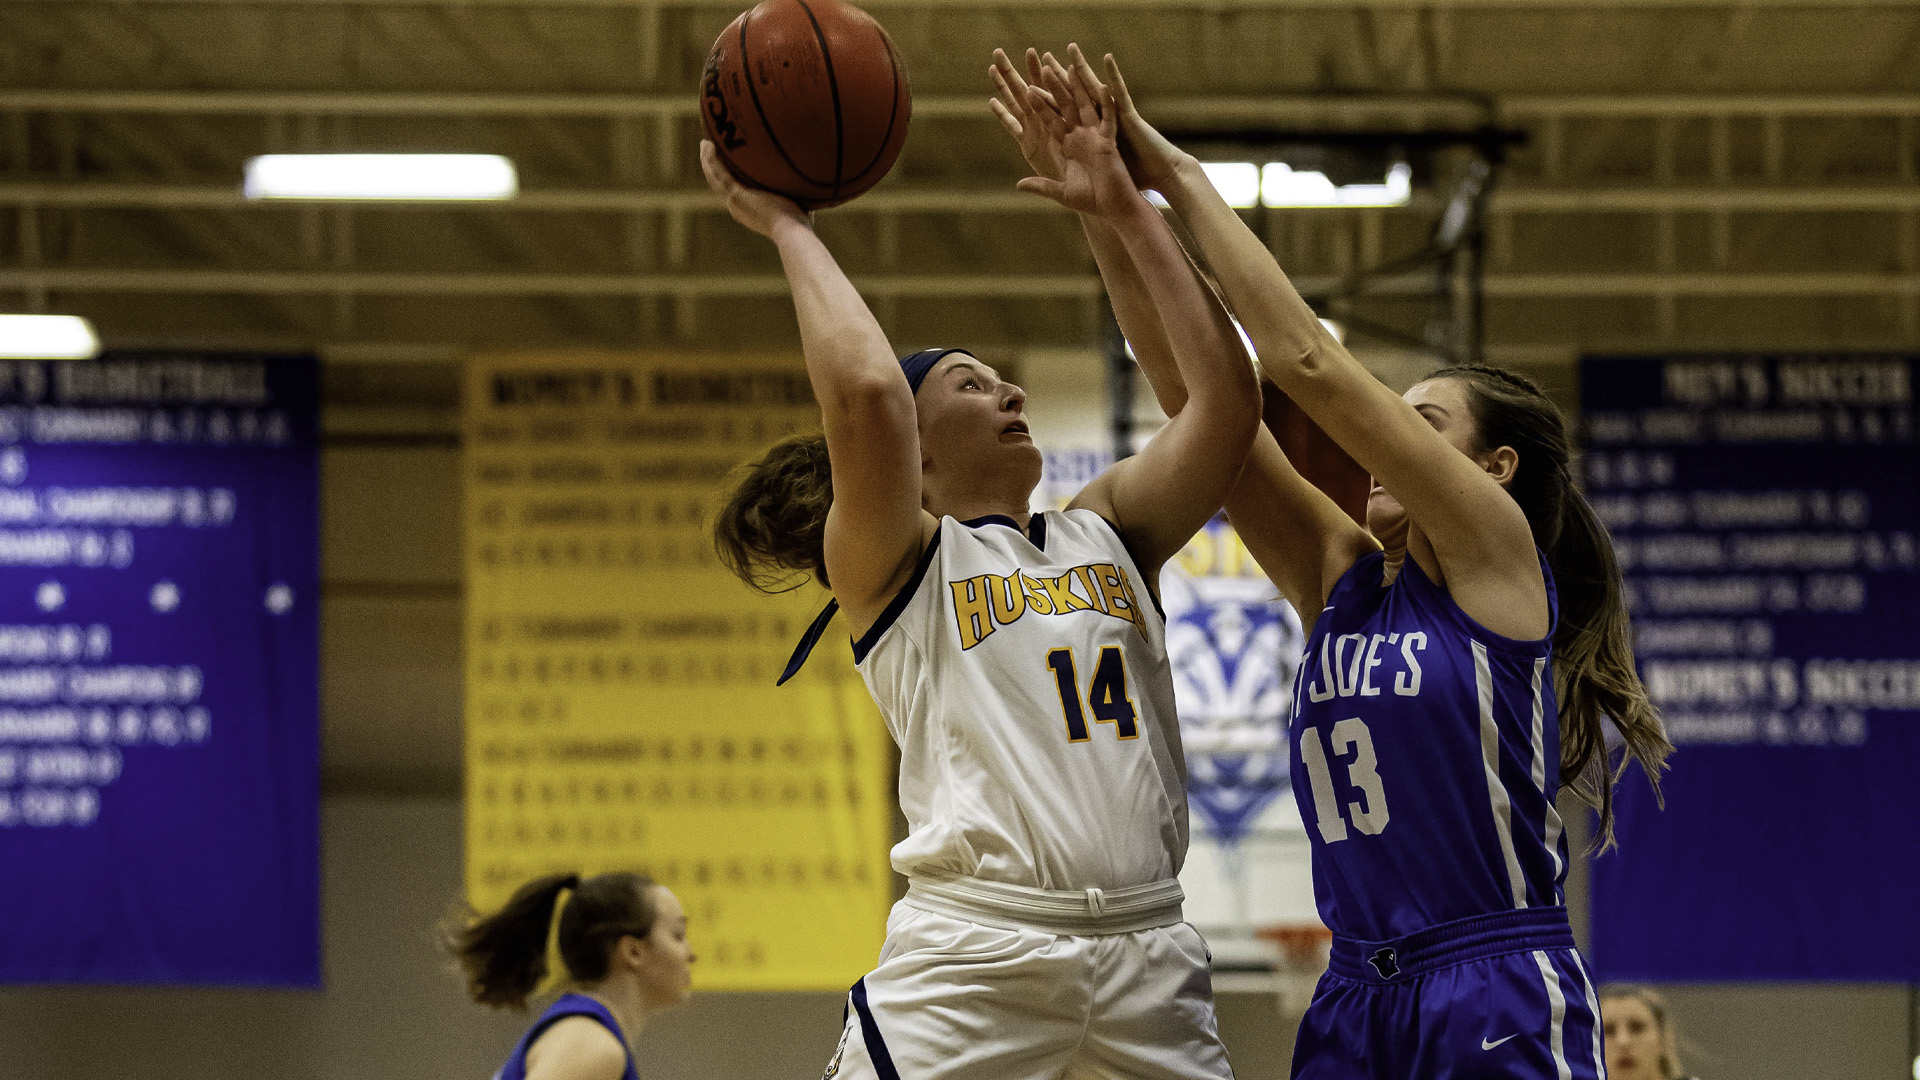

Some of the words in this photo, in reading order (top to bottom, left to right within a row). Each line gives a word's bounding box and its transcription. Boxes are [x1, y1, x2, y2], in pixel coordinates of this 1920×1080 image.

[949, 562, 1149, 651] HUSKIES
[1046, 644, 1140, 743] 14
[1308, 630, 1428, 704] JOE'S
[1299, 716, 1391, 845] 13
